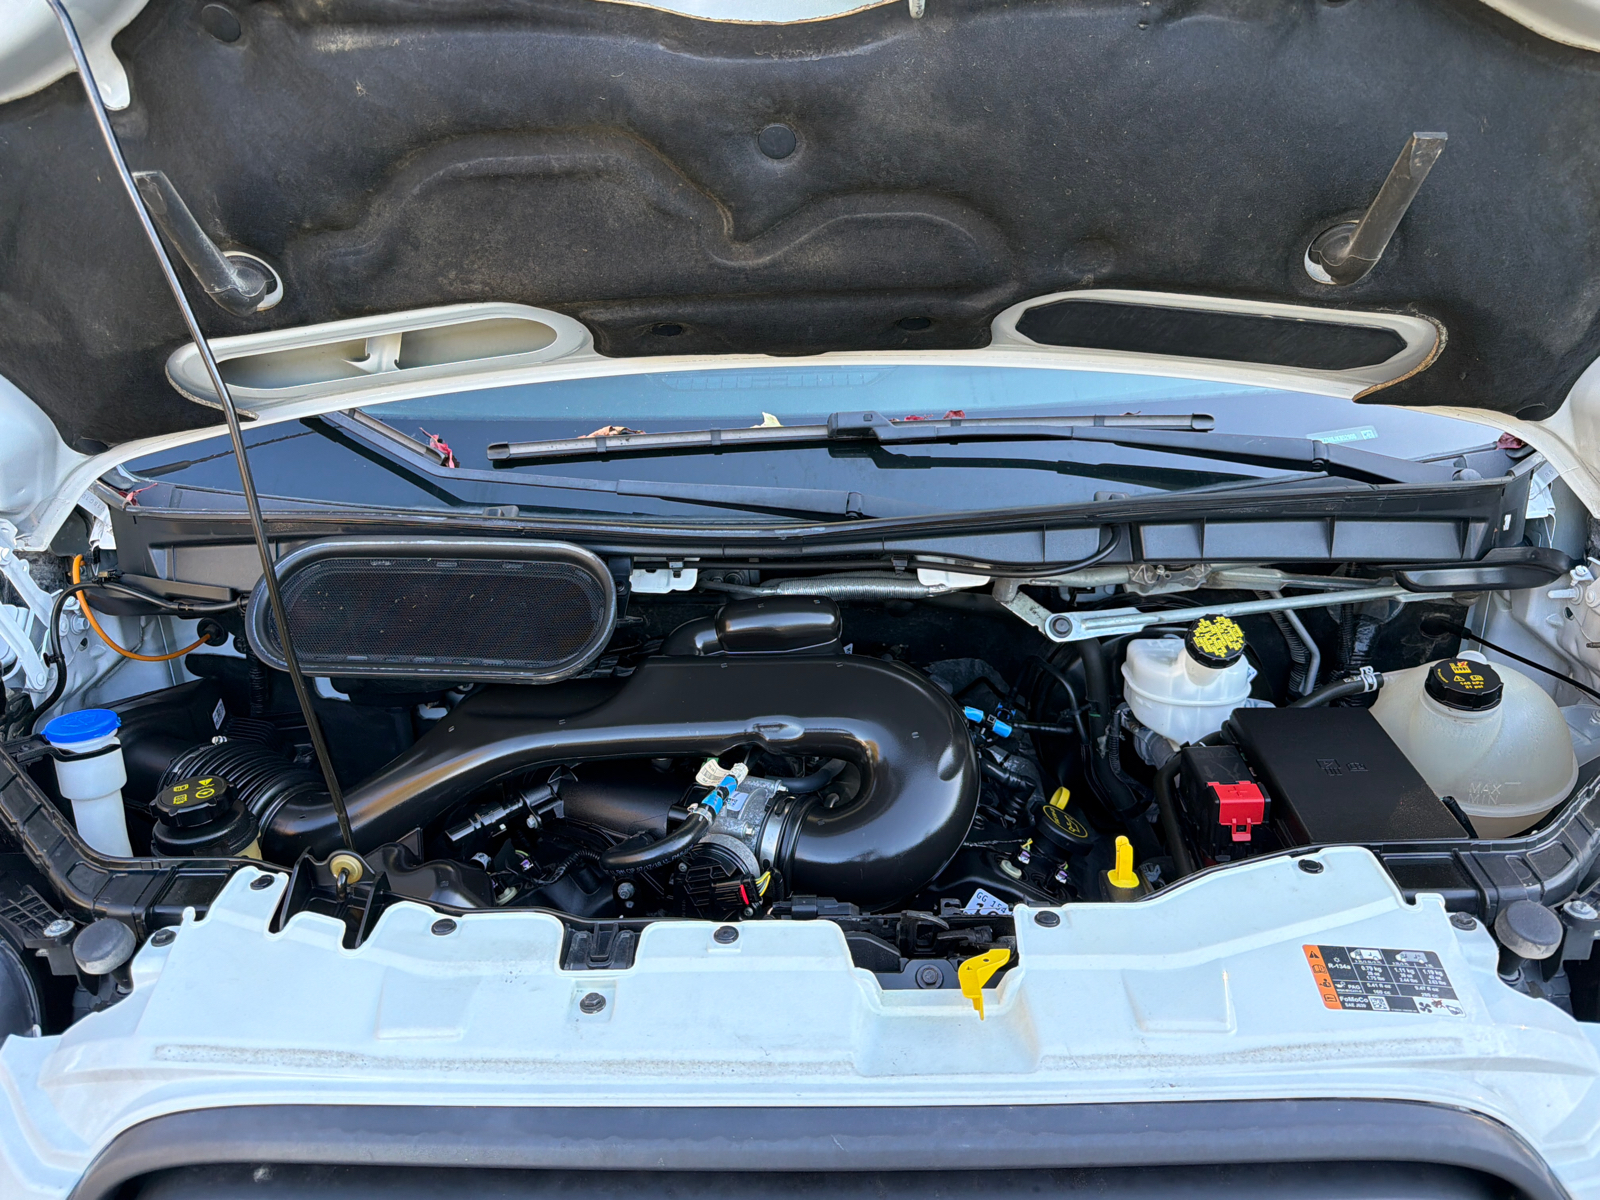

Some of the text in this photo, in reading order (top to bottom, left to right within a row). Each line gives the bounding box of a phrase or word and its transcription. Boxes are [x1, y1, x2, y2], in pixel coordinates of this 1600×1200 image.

[1468, 782, 1502, 794] MAX
[1468, 794, 1498, 805] MIN
[976, 892, 988, 902] GG
